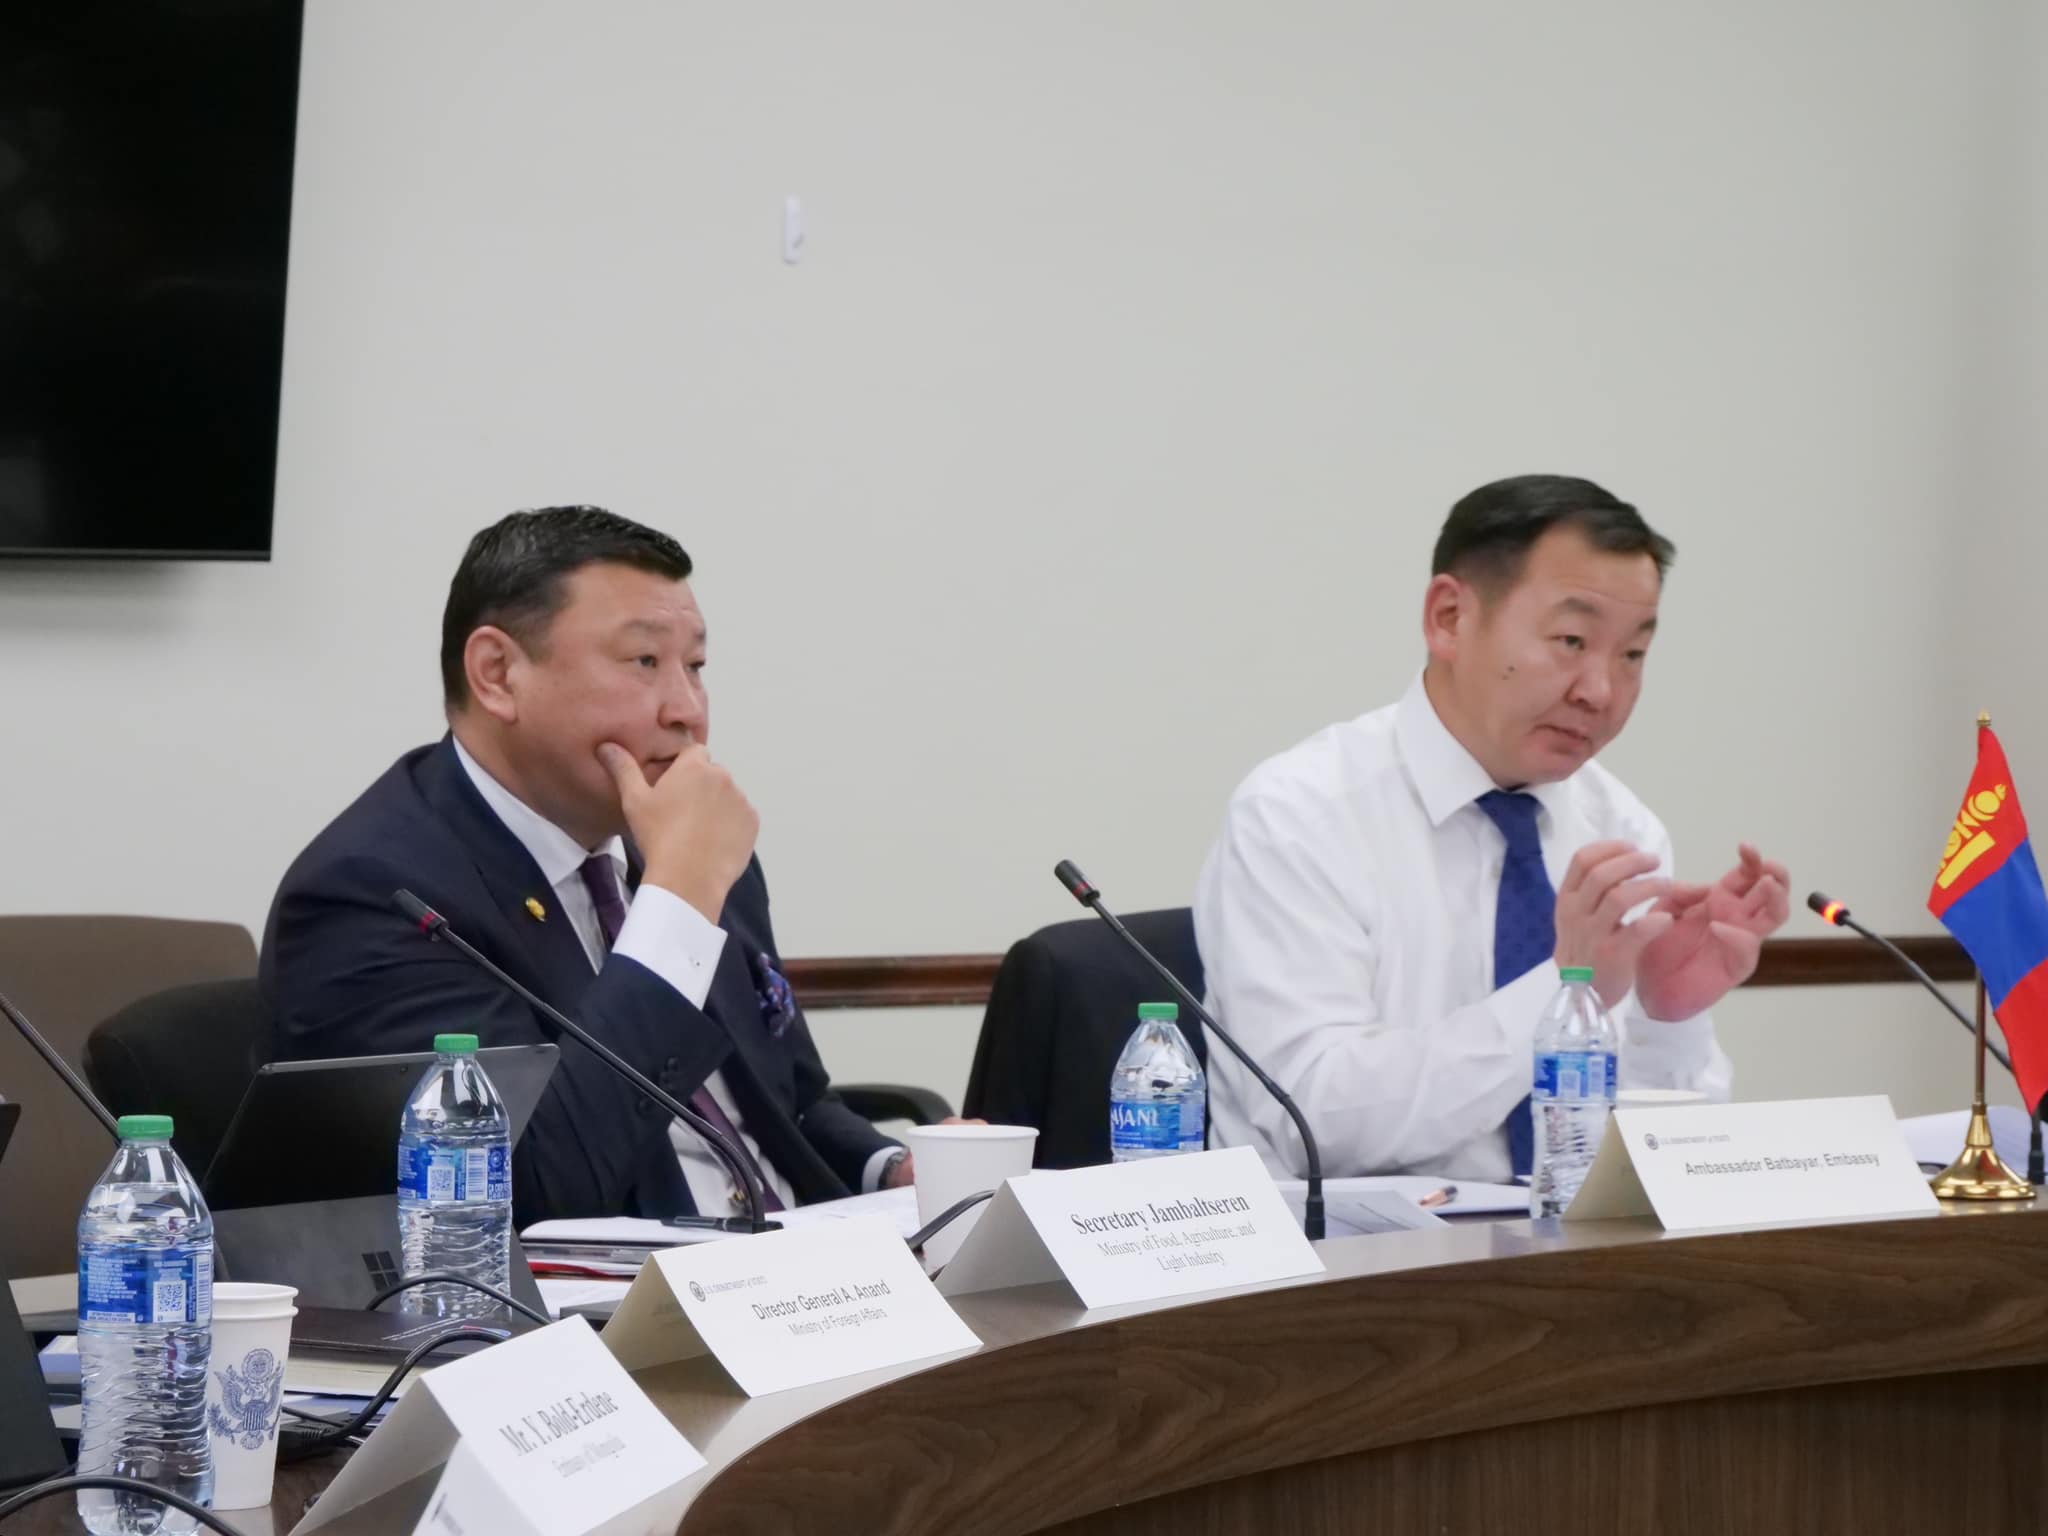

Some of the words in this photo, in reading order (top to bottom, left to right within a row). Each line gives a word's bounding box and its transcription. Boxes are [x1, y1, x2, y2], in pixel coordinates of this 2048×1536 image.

[1685, 1157, 1762, 1176] Ambassador
[1823, 1152, 1880, 1168] Embassy
[1070, 1208, 1149, 1235] Secretary
[1147, 1195, 1251, 1224] Jambaltseren
[1097, 1239, 1143, 1256] Ministry
[1142, 1234, 1154, 1250] of
[1239, 1222, 1257, 1236] and
[1156, 1253, 1187, 1273] Light
[1184, 1250, 1225, 1267] Industry
[751, 1300, 800, 1320] Director
[798, 1288, 842, 1311] General
[840, 1287, 857, 1303] A.
[854, 1279, 891, 1299] Anand
